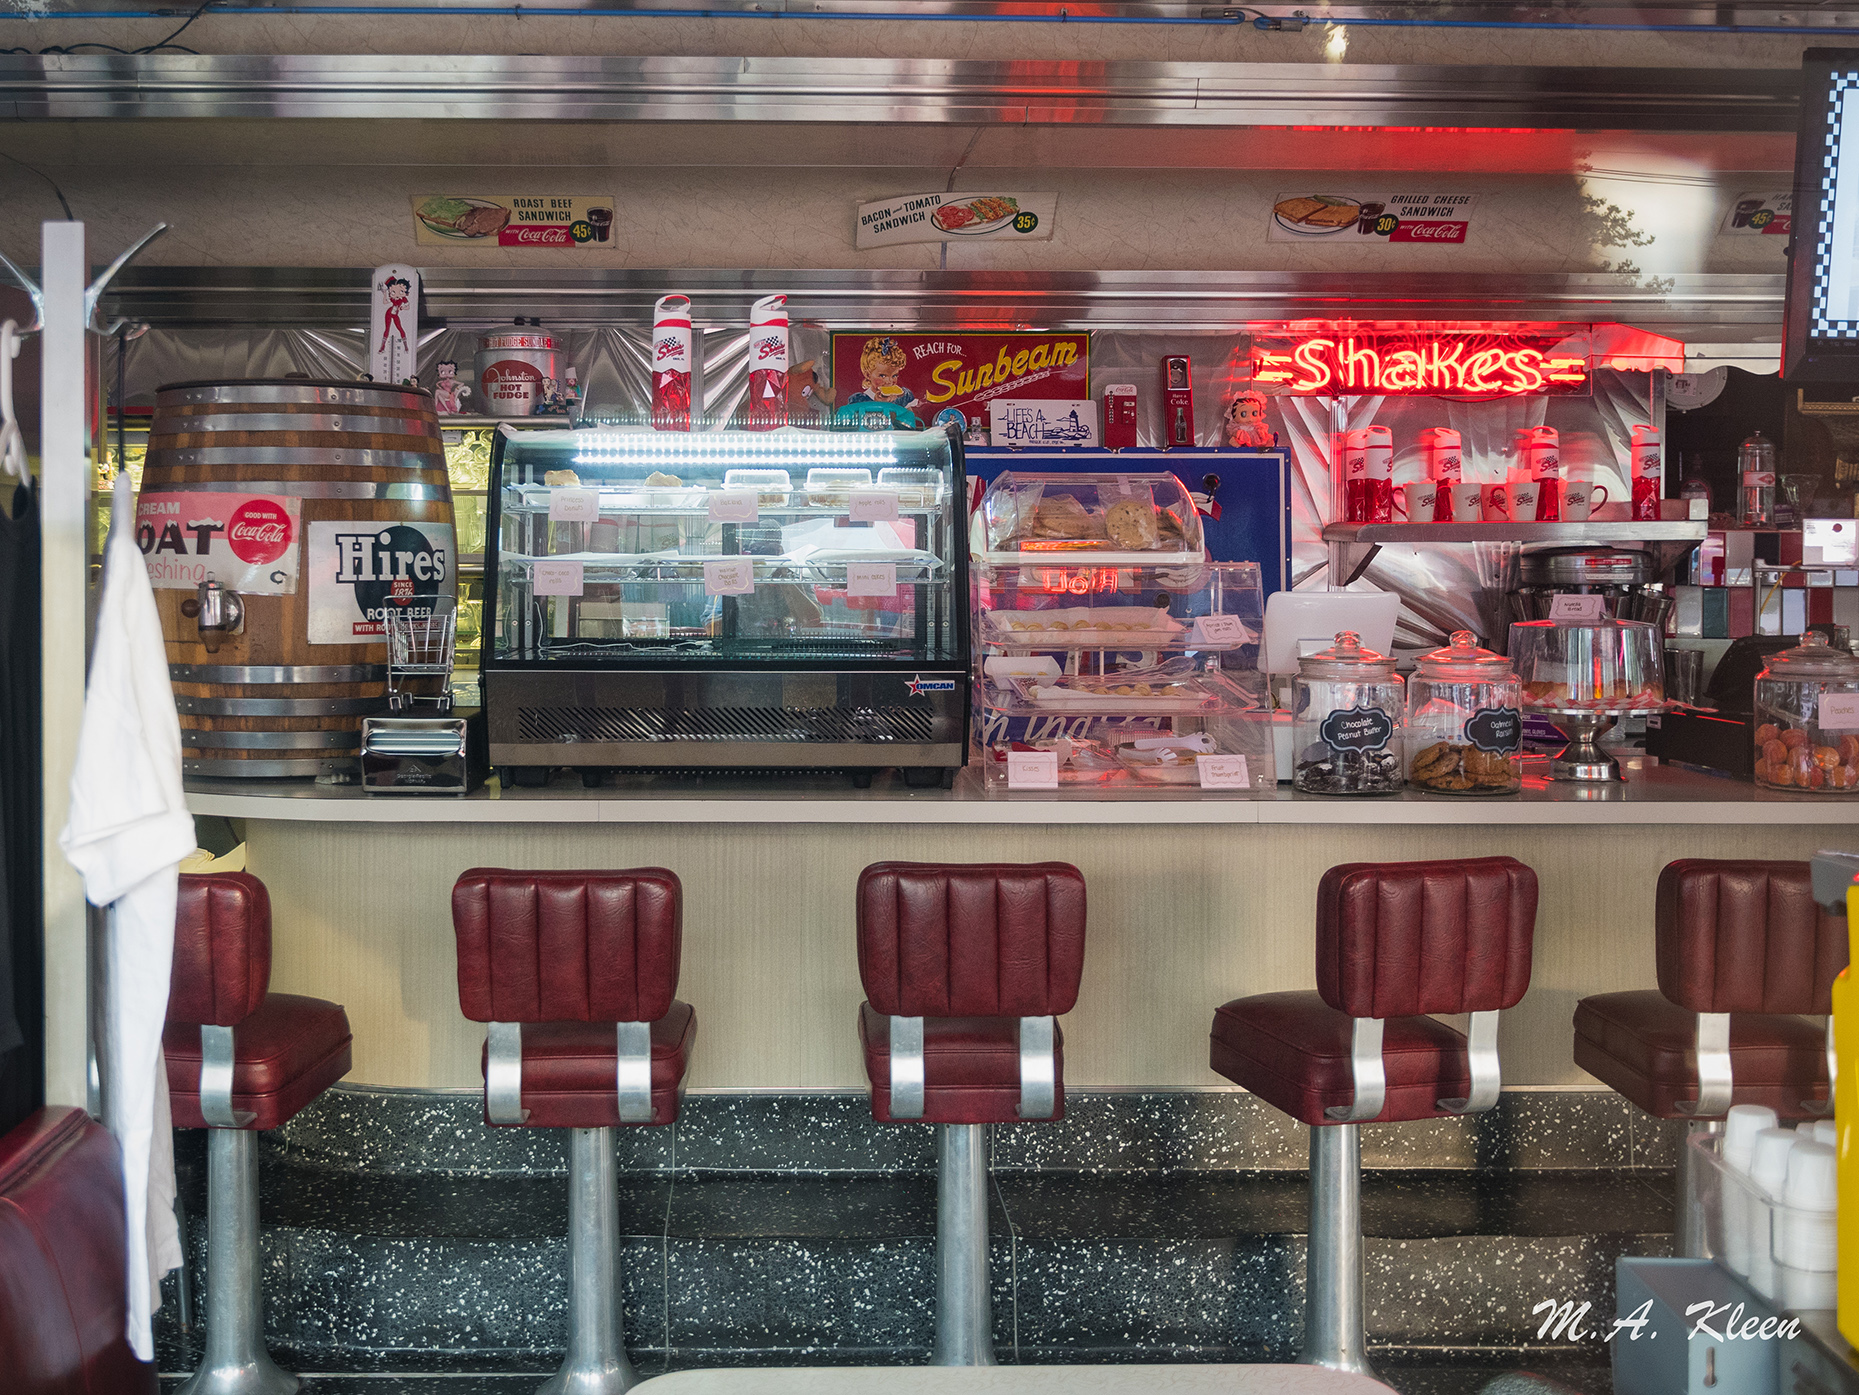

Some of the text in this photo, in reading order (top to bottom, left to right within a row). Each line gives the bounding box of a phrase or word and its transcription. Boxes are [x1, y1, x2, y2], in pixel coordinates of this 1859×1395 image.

[513, 198, 573, 208] ROAST BEEF
[1390, 195, 1471, 205] GRILLED CHEESE
[518, 210, 572, 222] SANDWICH
[861, 208, 892, 226] BACON
[903, 195, 941, 212] TOMATO
[1400, 206, 1455, 217] SANDWICH
[873, 211, 926, 234] SANDWICH
[1016, 215, 1036, 229] 35¢
[1377, 217, 1396, 231] 30¢
[518, 228, 567, 243] Coca-Cola
[572, 224, 591, 238] 45¢
[1411, 224, 1463, 239] Coca-Cola
[912, 342, 945, 360] REACH
[1291, 337, 1546, 392] Shakes
[486, 367, 536, 387] Johnston
[926, 341, 1079, 403] Sunbeam
[493, 392, 529, 400] FUDGE
[1006, 422, 1046, 440] BEACH
[138, 501, 181, 515] CREAM
[262, 512, 277, 520] WITH
[231, 521, 287, 543] Coca-Cola
[336, 531, 445, 583] Hires
[354, 623, 374, 632] WITH
[1341, 717, 1374, 730] Chocolate
[1490, 718, 1514, 730] Oatmeal
[1337, 729, 1361, 741] Peanut
